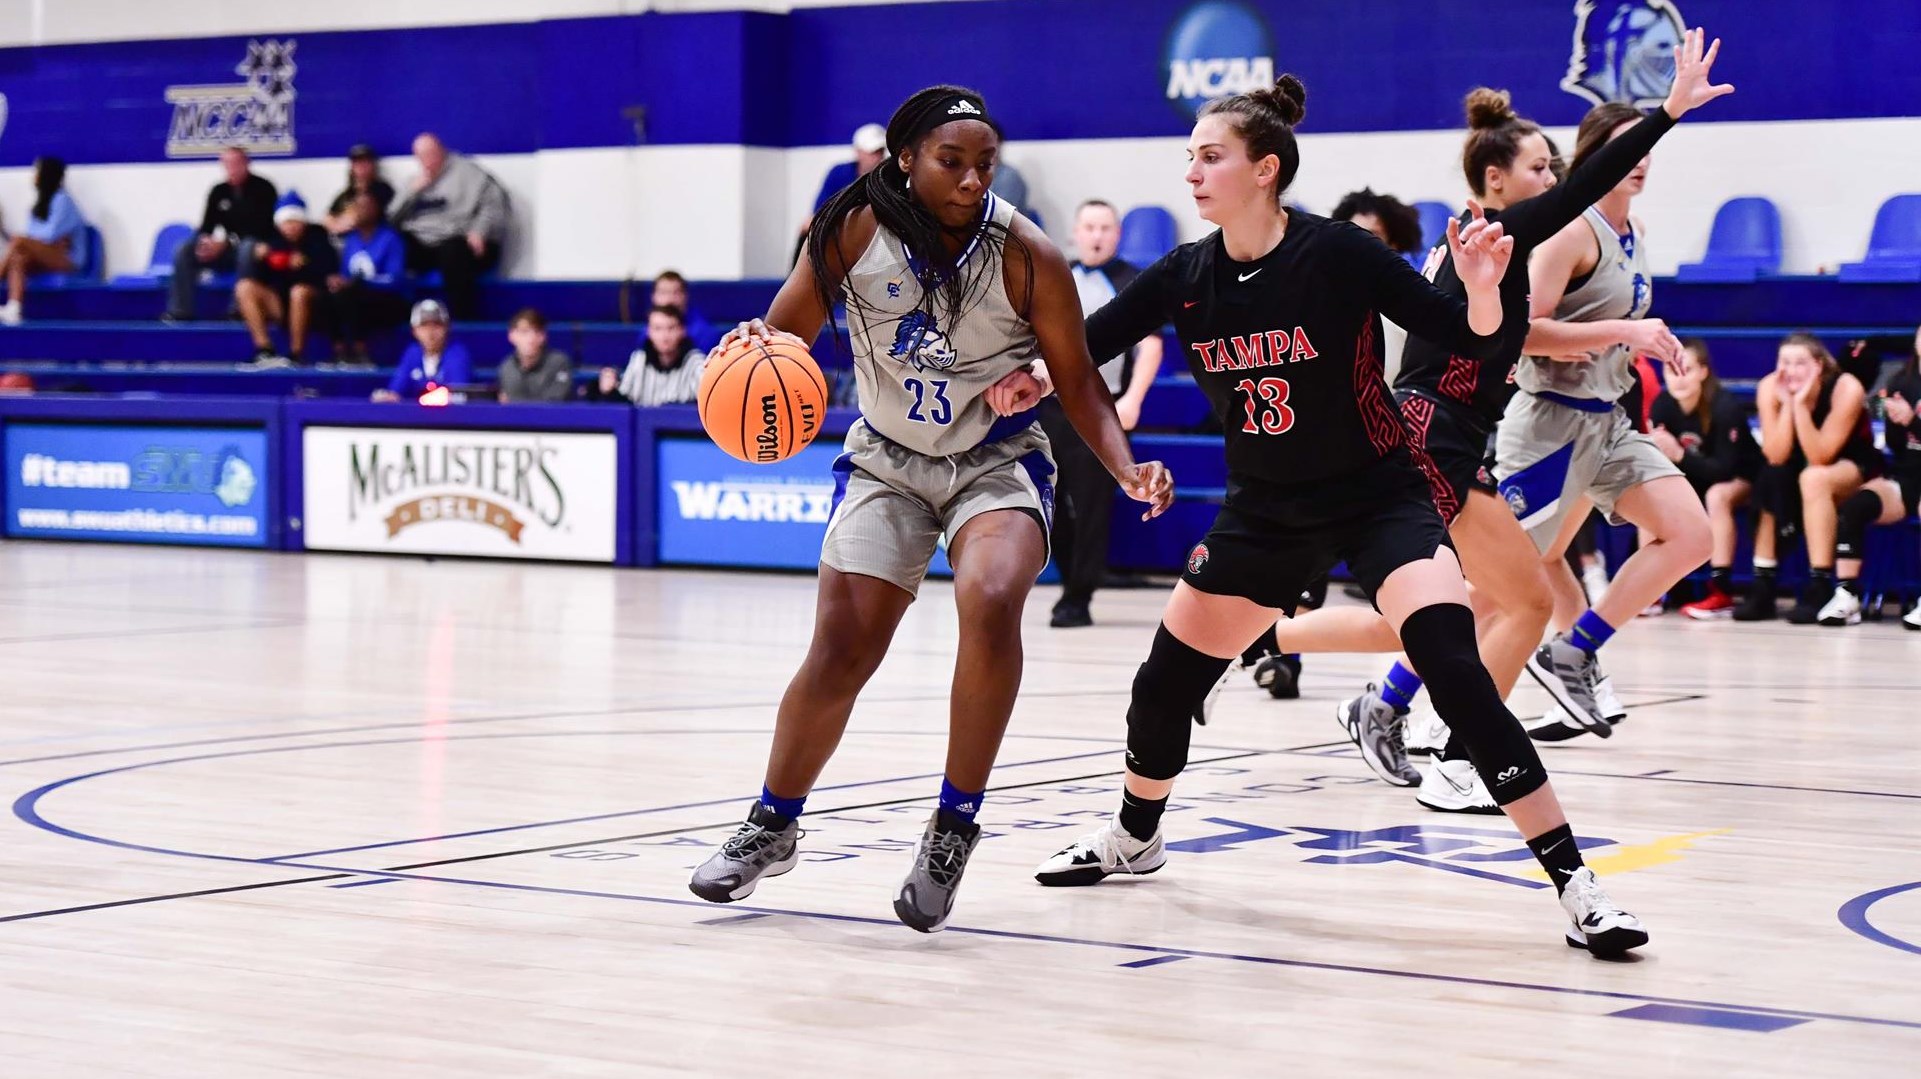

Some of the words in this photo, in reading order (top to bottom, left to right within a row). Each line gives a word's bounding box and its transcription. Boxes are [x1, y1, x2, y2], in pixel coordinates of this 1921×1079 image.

[1166, 56, 1274, 99] NCAA
[947, 107, 981, 115] adidas
[1192, 326, 1318, 372] TAMPA
[904, 377, 953, 427] 23
[1234, 377, 1295, 435] 13
[756, 394, 779, 462] Wilson
[22, 452, 131, 490] #team
[419, 496, 488, 521] DELI
